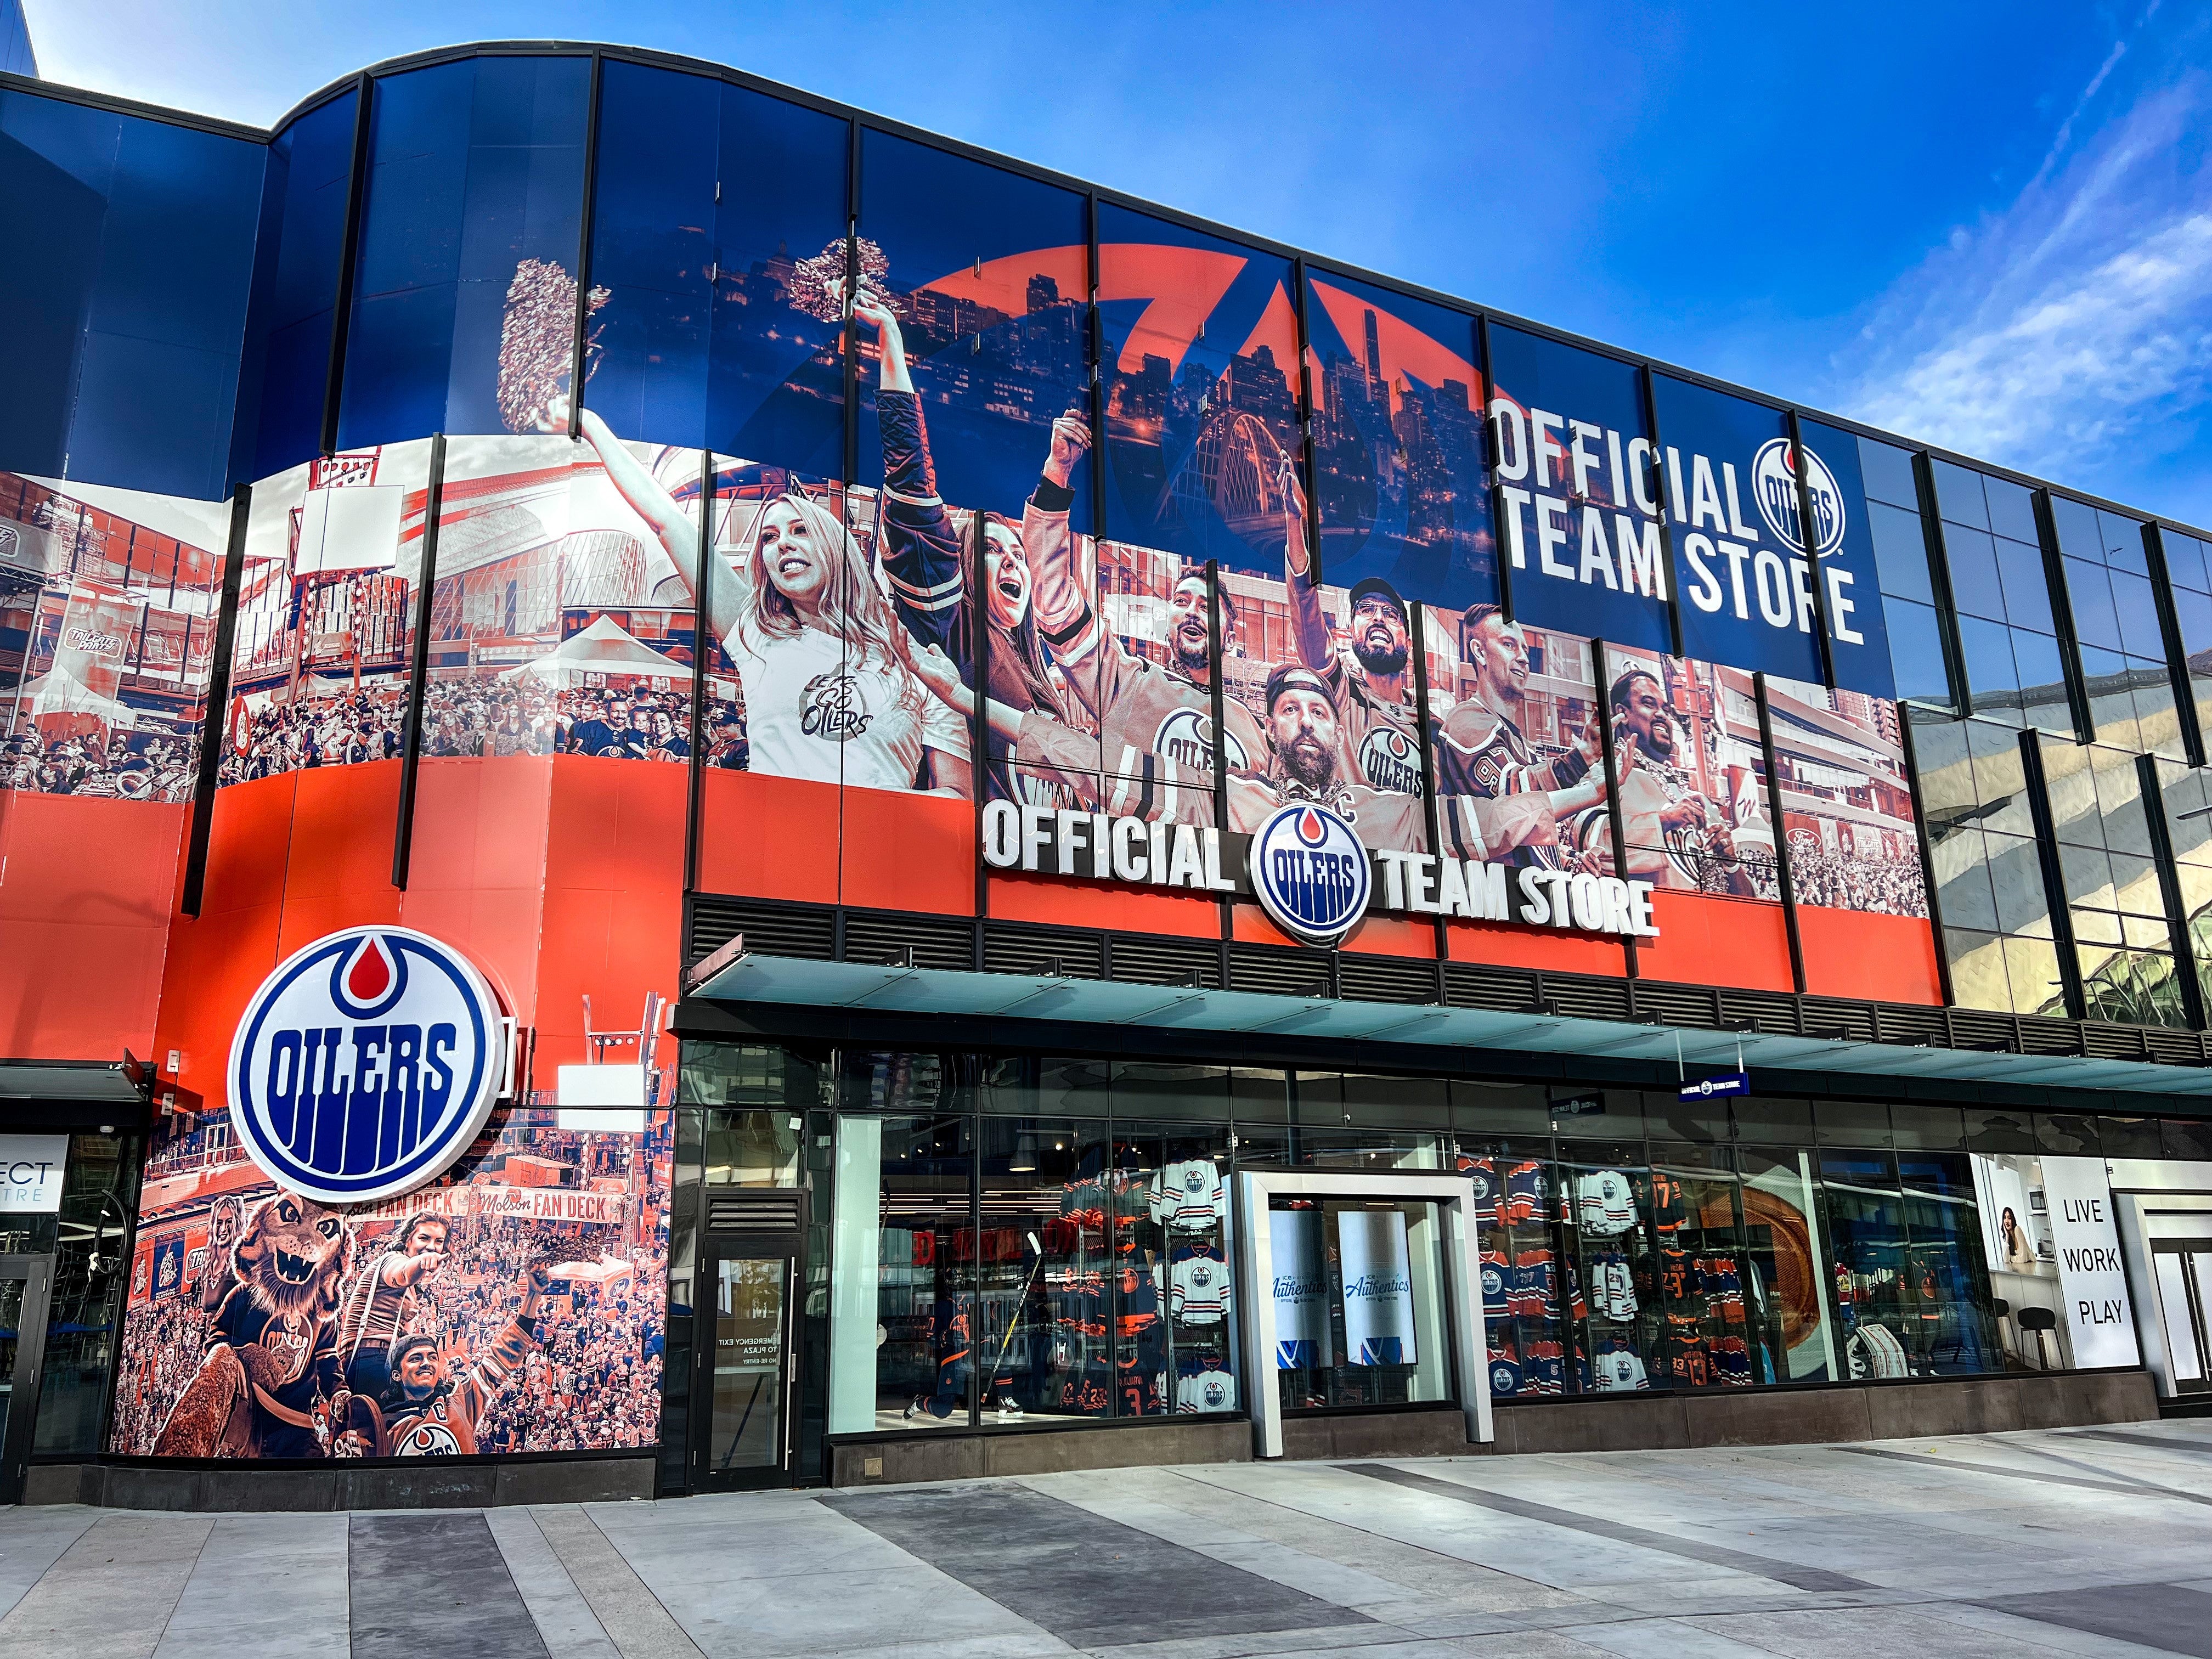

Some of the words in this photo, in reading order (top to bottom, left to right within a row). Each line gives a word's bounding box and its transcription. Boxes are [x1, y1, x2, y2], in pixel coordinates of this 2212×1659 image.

[1490, 398, 1758, 541] OFFICIAL
[1502, 485, 1667, 601] TEAM
[70, 629, 120, 646] TAILGATE
[75, 640, 117, 651] PARTY
[815, 687, 853, 709] GO
[801, 704, 874, 739] OILERS
[1168, 737, 1240, 772] OILE
[1367, 748, 1423, 799] OILERS
[1333, 791, 1357, 826] C
[983, 799, 1235, 891] OFFICIAL
[1793, 831, 1814, 846] Ford
[1273, 848, 1355, 924] OILERS
[1374, 849, 1510, 921] TEAM
[1519, 866, 1660, 937] STORE
[266, 1023, 456, 1176] OILERS
[376, 1194, 408, 1218] FAN
[413, 1192, 454, 1214] DECK
[481, 1193, 531, 1213] Molson
[534, 1193, 561, 1217] FAN
[568, 1195, 606, 1220] DECK
[2064, 1199, 2104, 1223] LIVE
[2063, 1248, 2120, 1272] WORK
[1346, 1277, 1409, 1298] Authentics
[2080, 1300, 2122, 1324] PLAY
[432, 1402, 448, 1423] C
